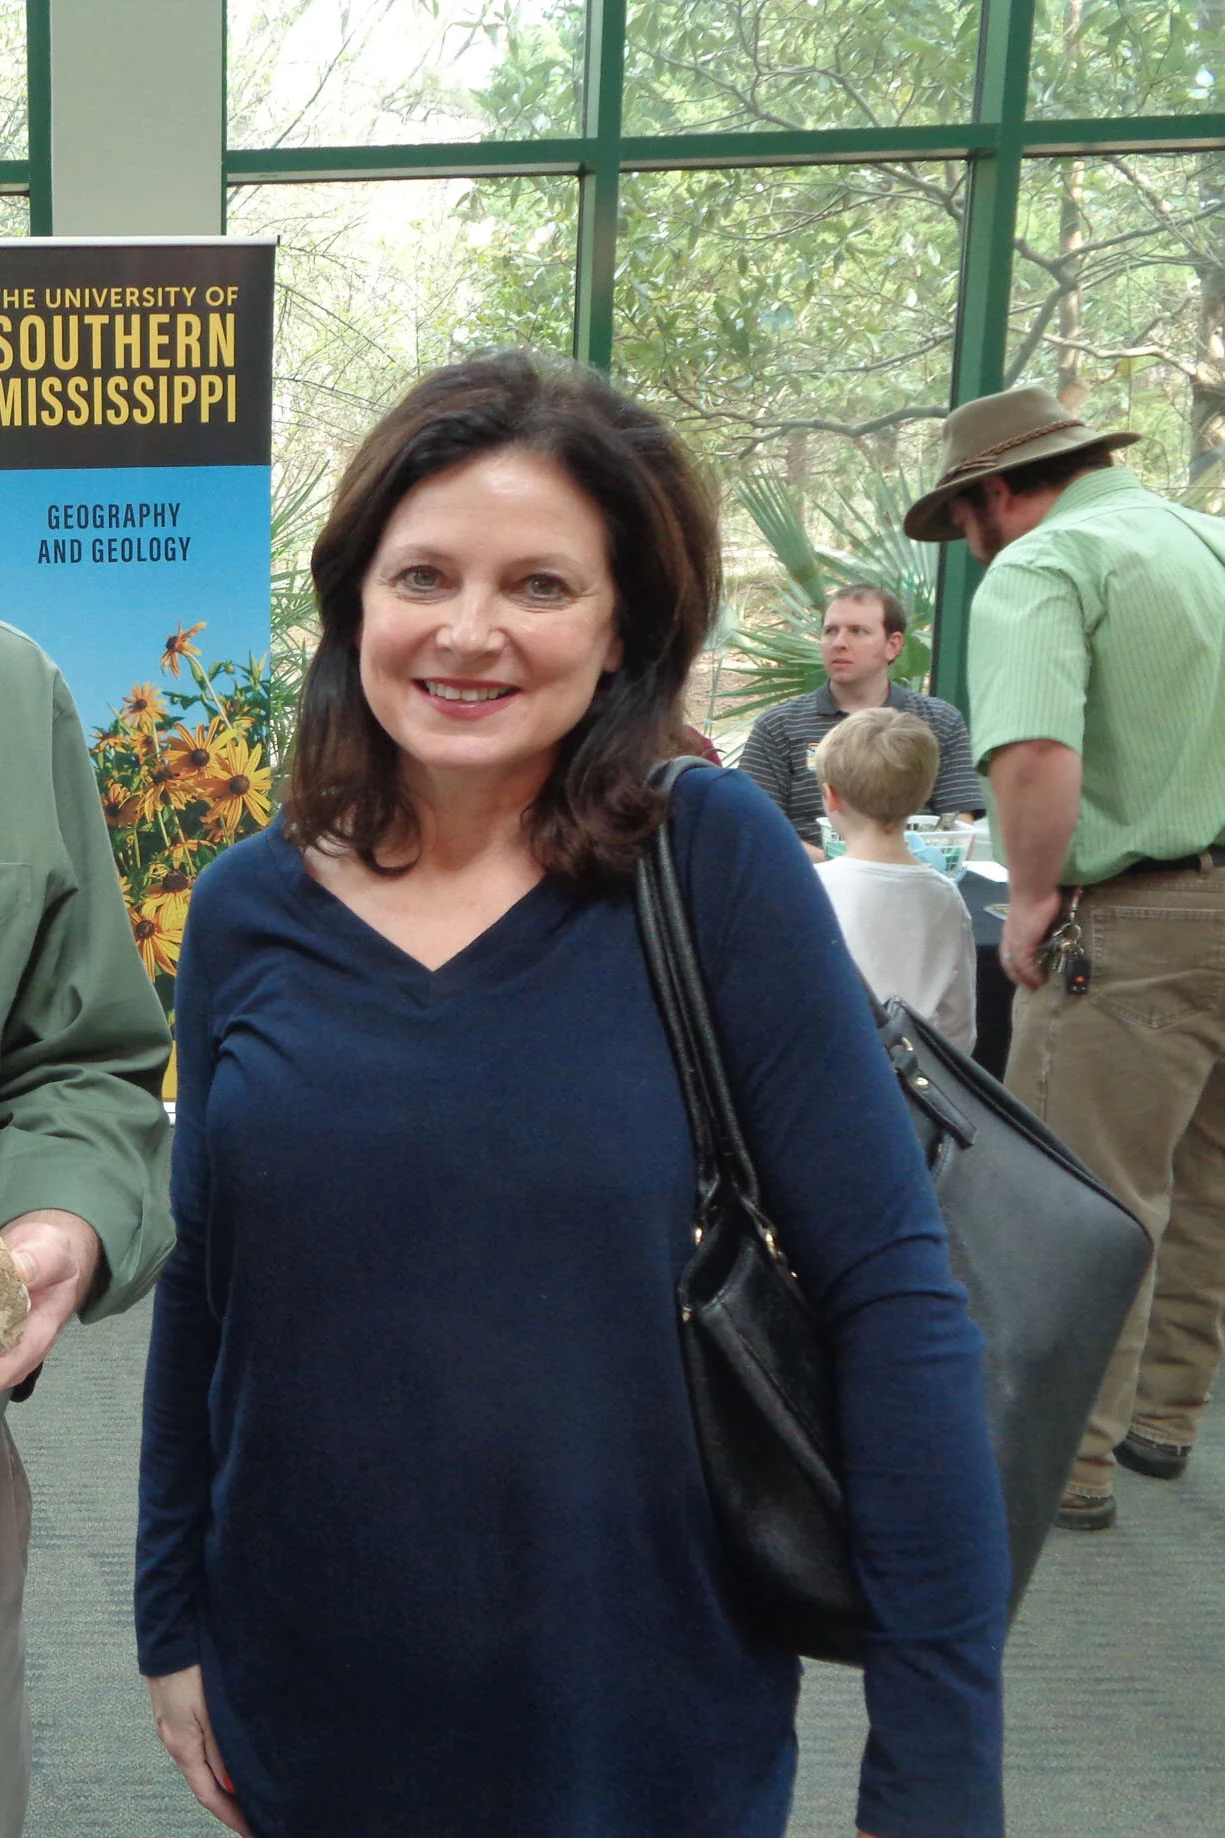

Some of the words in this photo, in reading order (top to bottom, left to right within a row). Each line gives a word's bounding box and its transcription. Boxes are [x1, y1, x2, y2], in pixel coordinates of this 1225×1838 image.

[45, 286, 197, 309] UNIVERSITY
[205, 286, 239, 307] OF
[47, 503, 181, 530] GEOGRAPHY
[37, 539, 82, 564] AND
[91, 536, 192, 562] GEOLOGY
